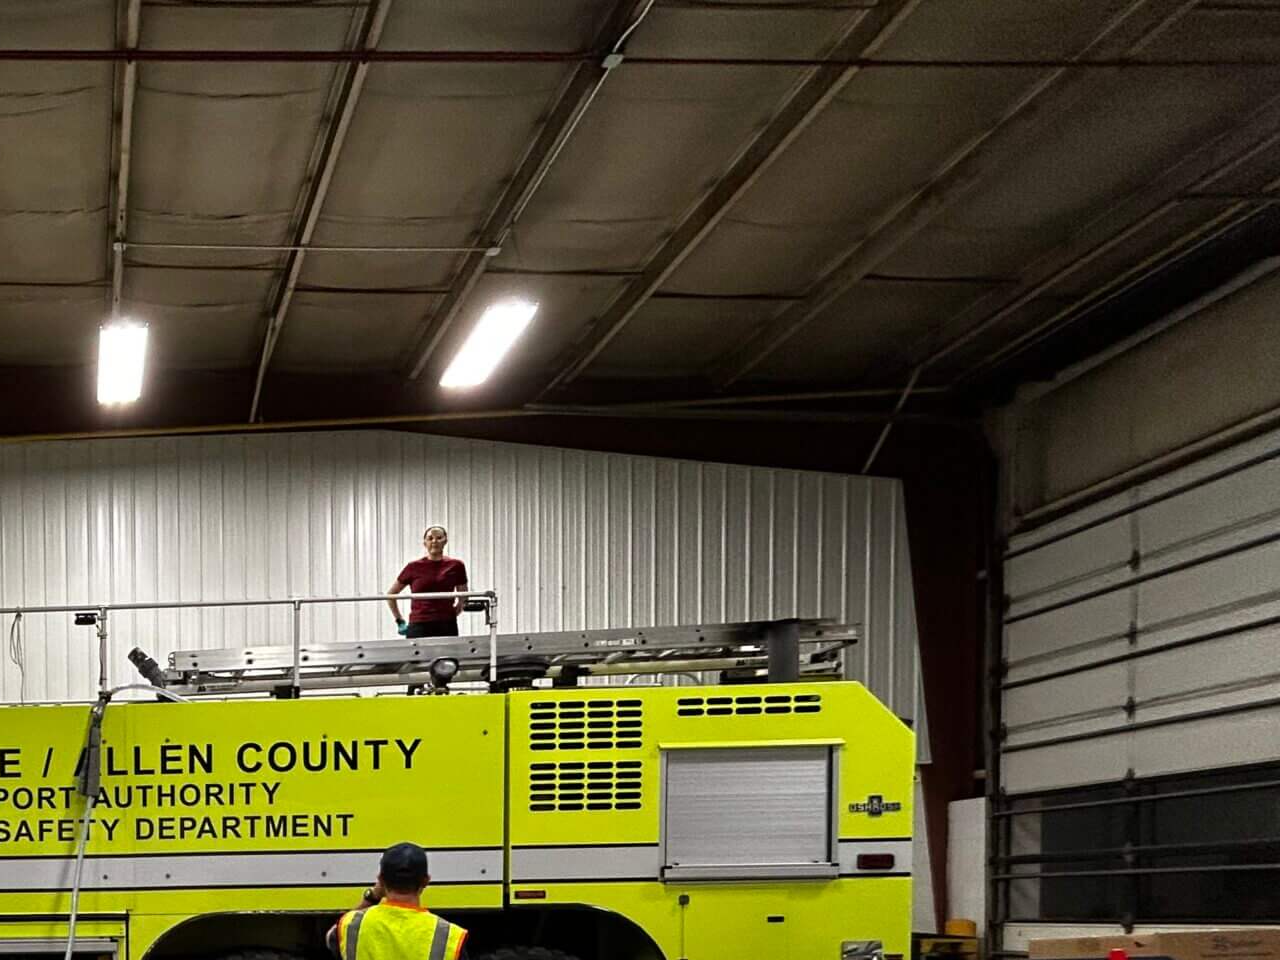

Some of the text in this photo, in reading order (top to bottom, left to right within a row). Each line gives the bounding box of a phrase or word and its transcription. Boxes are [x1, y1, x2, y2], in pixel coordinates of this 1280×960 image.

[41, 747, 54, 778] /
[236, 738, 422, 773] COUNTY
[91, 782, 282, 809] AUTHORITY
[134, 814, 355, 841] DEPARTMENT
